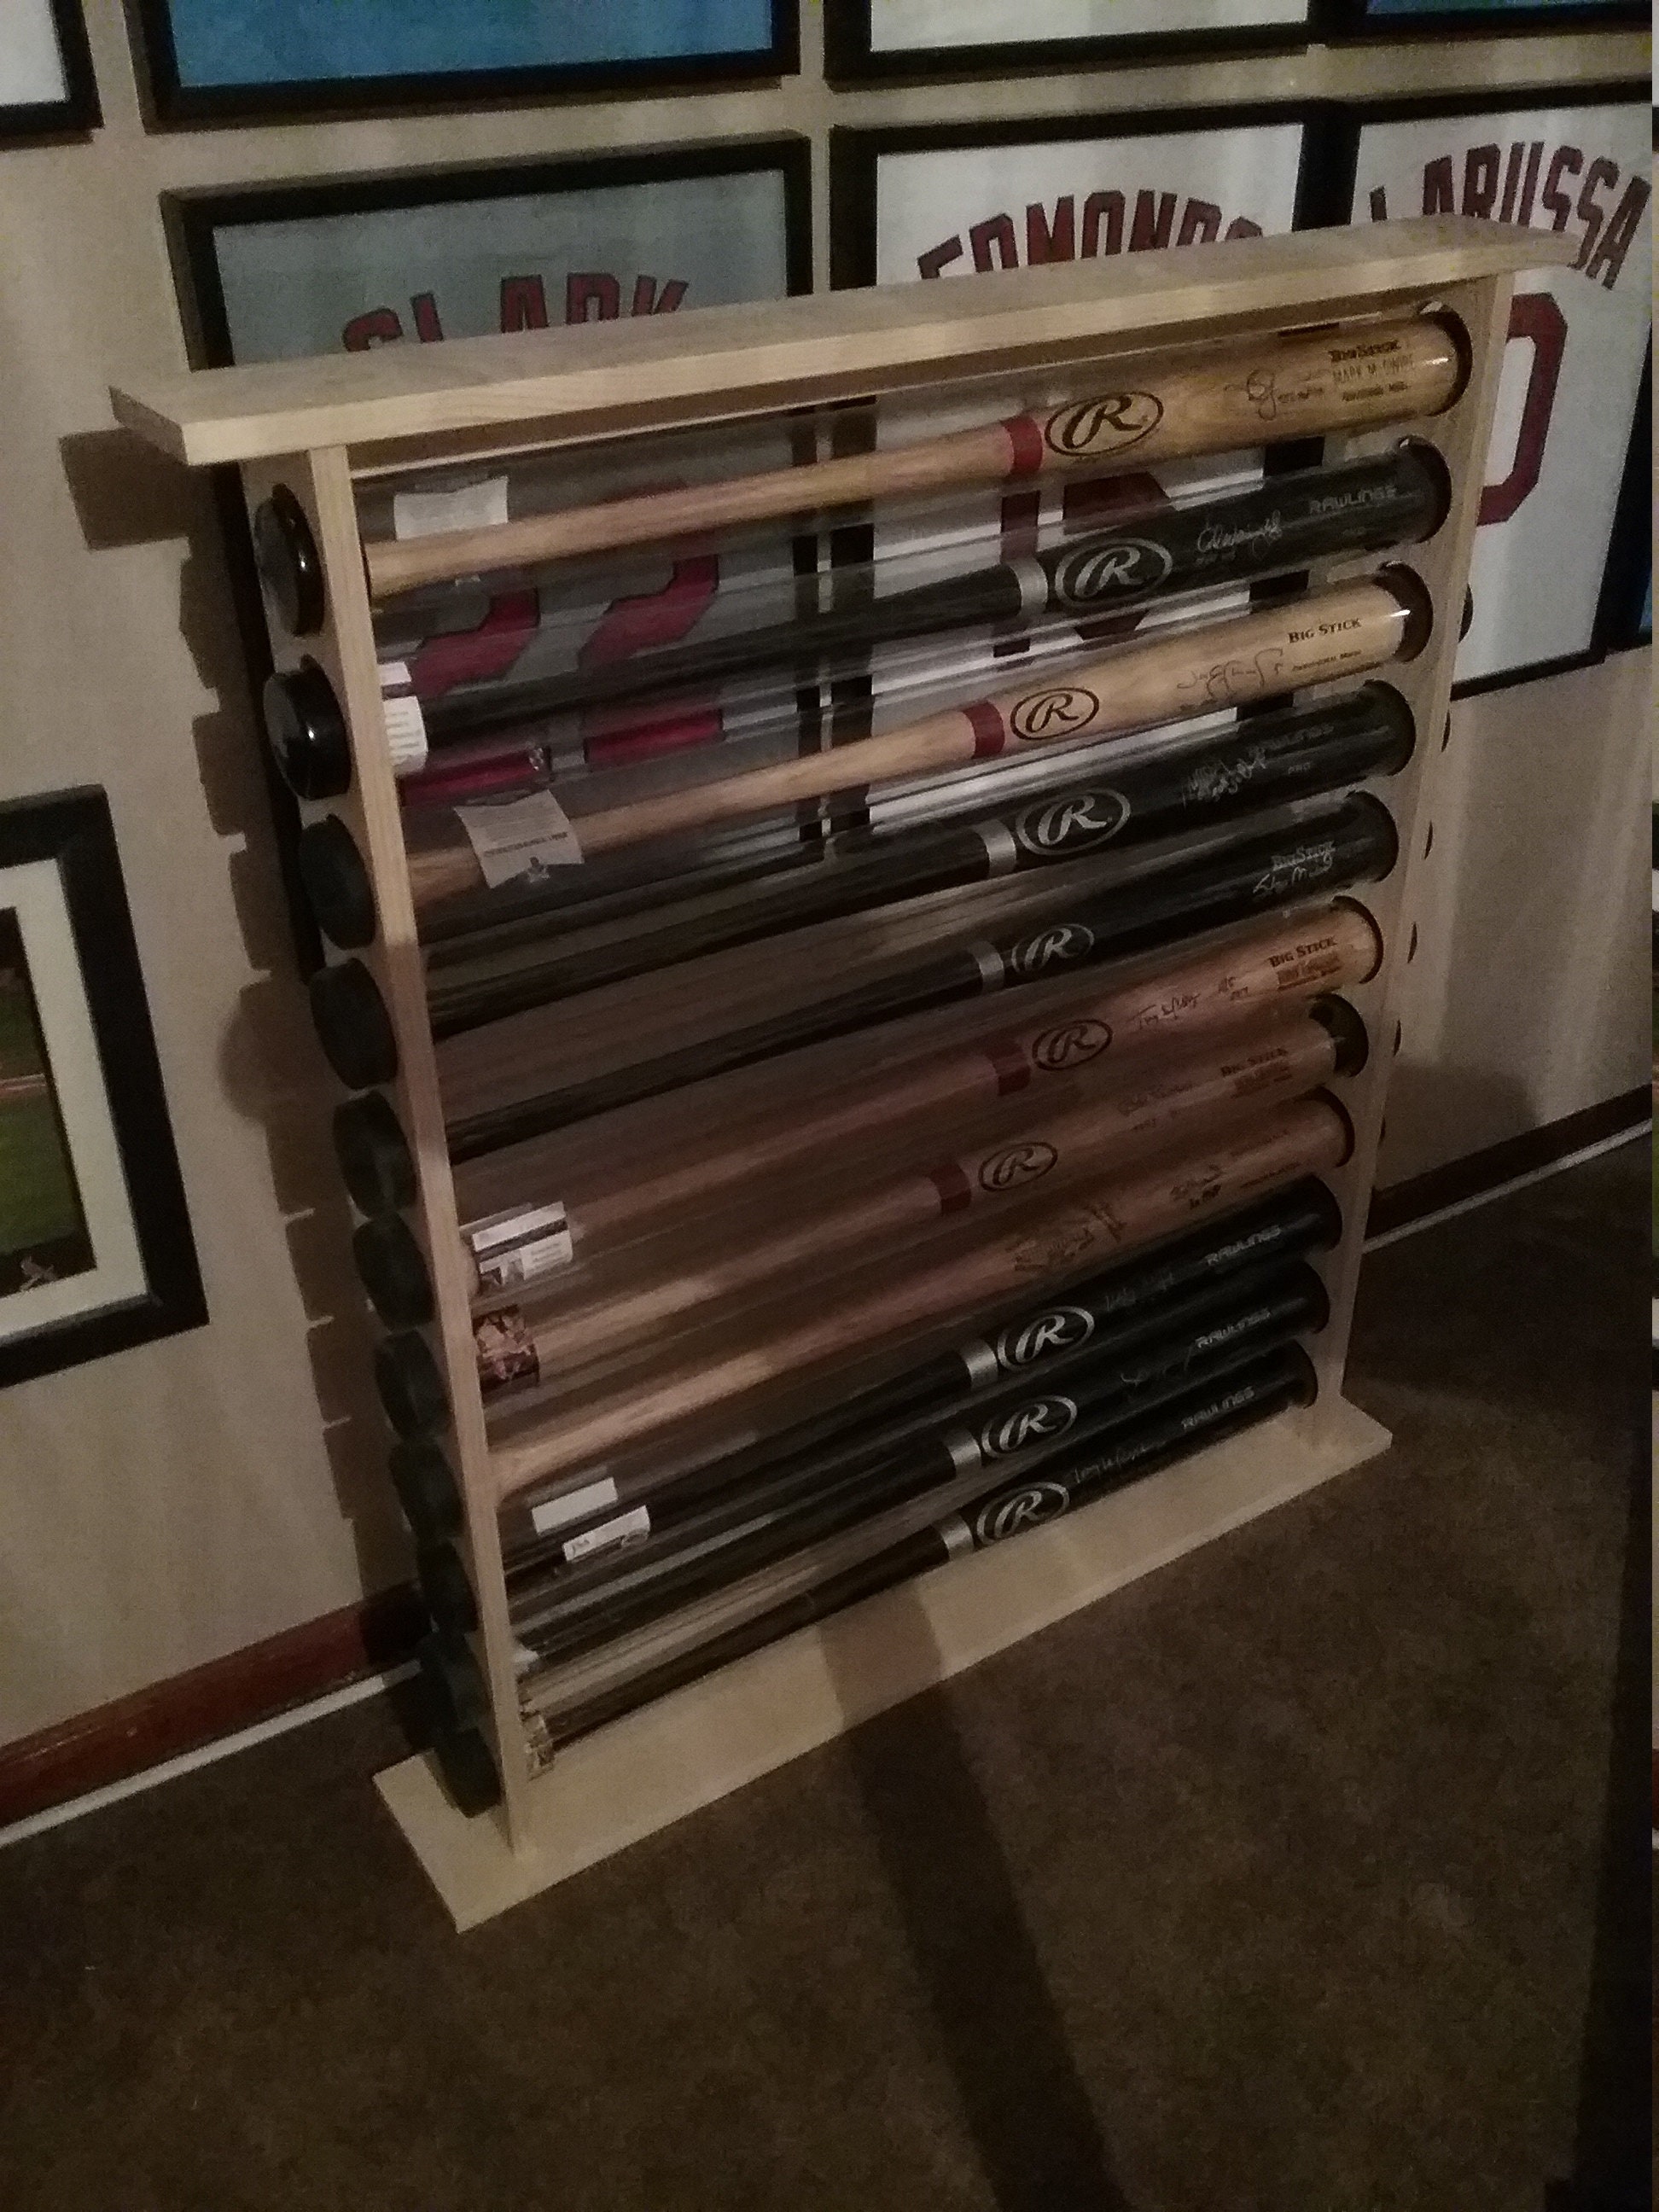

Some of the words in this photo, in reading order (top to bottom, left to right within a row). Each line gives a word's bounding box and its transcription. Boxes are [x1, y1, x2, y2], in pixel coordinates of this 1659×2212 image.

[1308, 484, 1397, 514] RAWLINGS
[1288, 629, 1315, 643] BIG
[1318, 618, 1362, 635] STICK
[1268, 951, 1295, 967] BIG
[1295, 936, 1337, 958] STICK
